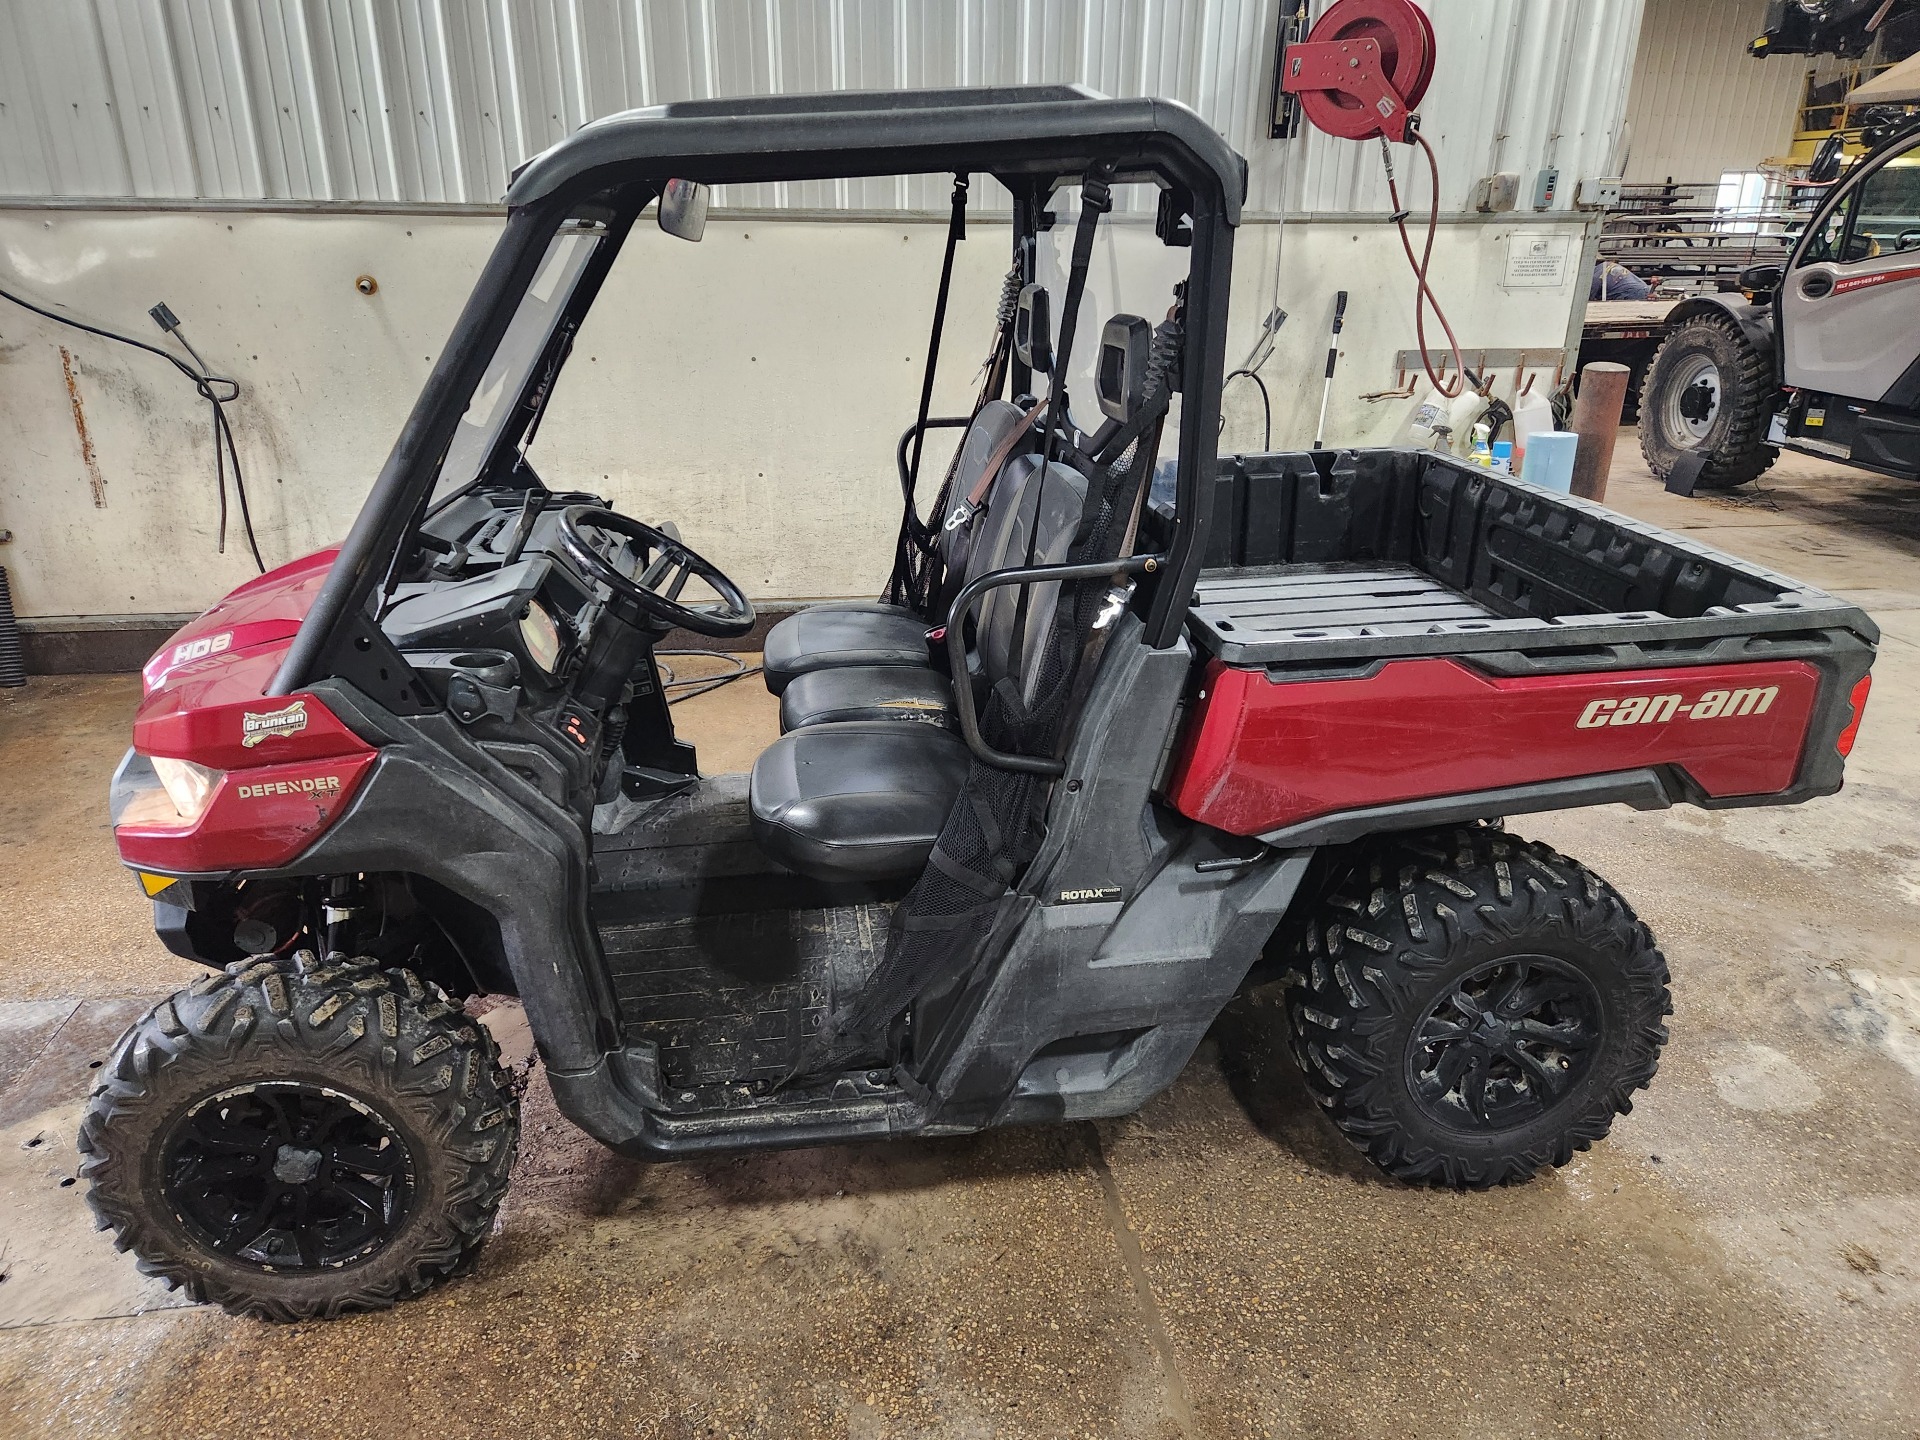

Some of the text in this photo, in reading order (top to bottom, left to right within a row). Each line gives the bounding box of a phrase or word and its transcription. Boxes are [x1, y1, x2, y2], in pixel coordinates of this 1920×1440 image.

[172, 633, 232, 665] HD8
[247, 714, 304, 731] Brunkan
[238, 776, 340, 799] DEFENDER
[308, 788, 340, 801] XT
[1061, 889, 1103, 900] ROTAX
